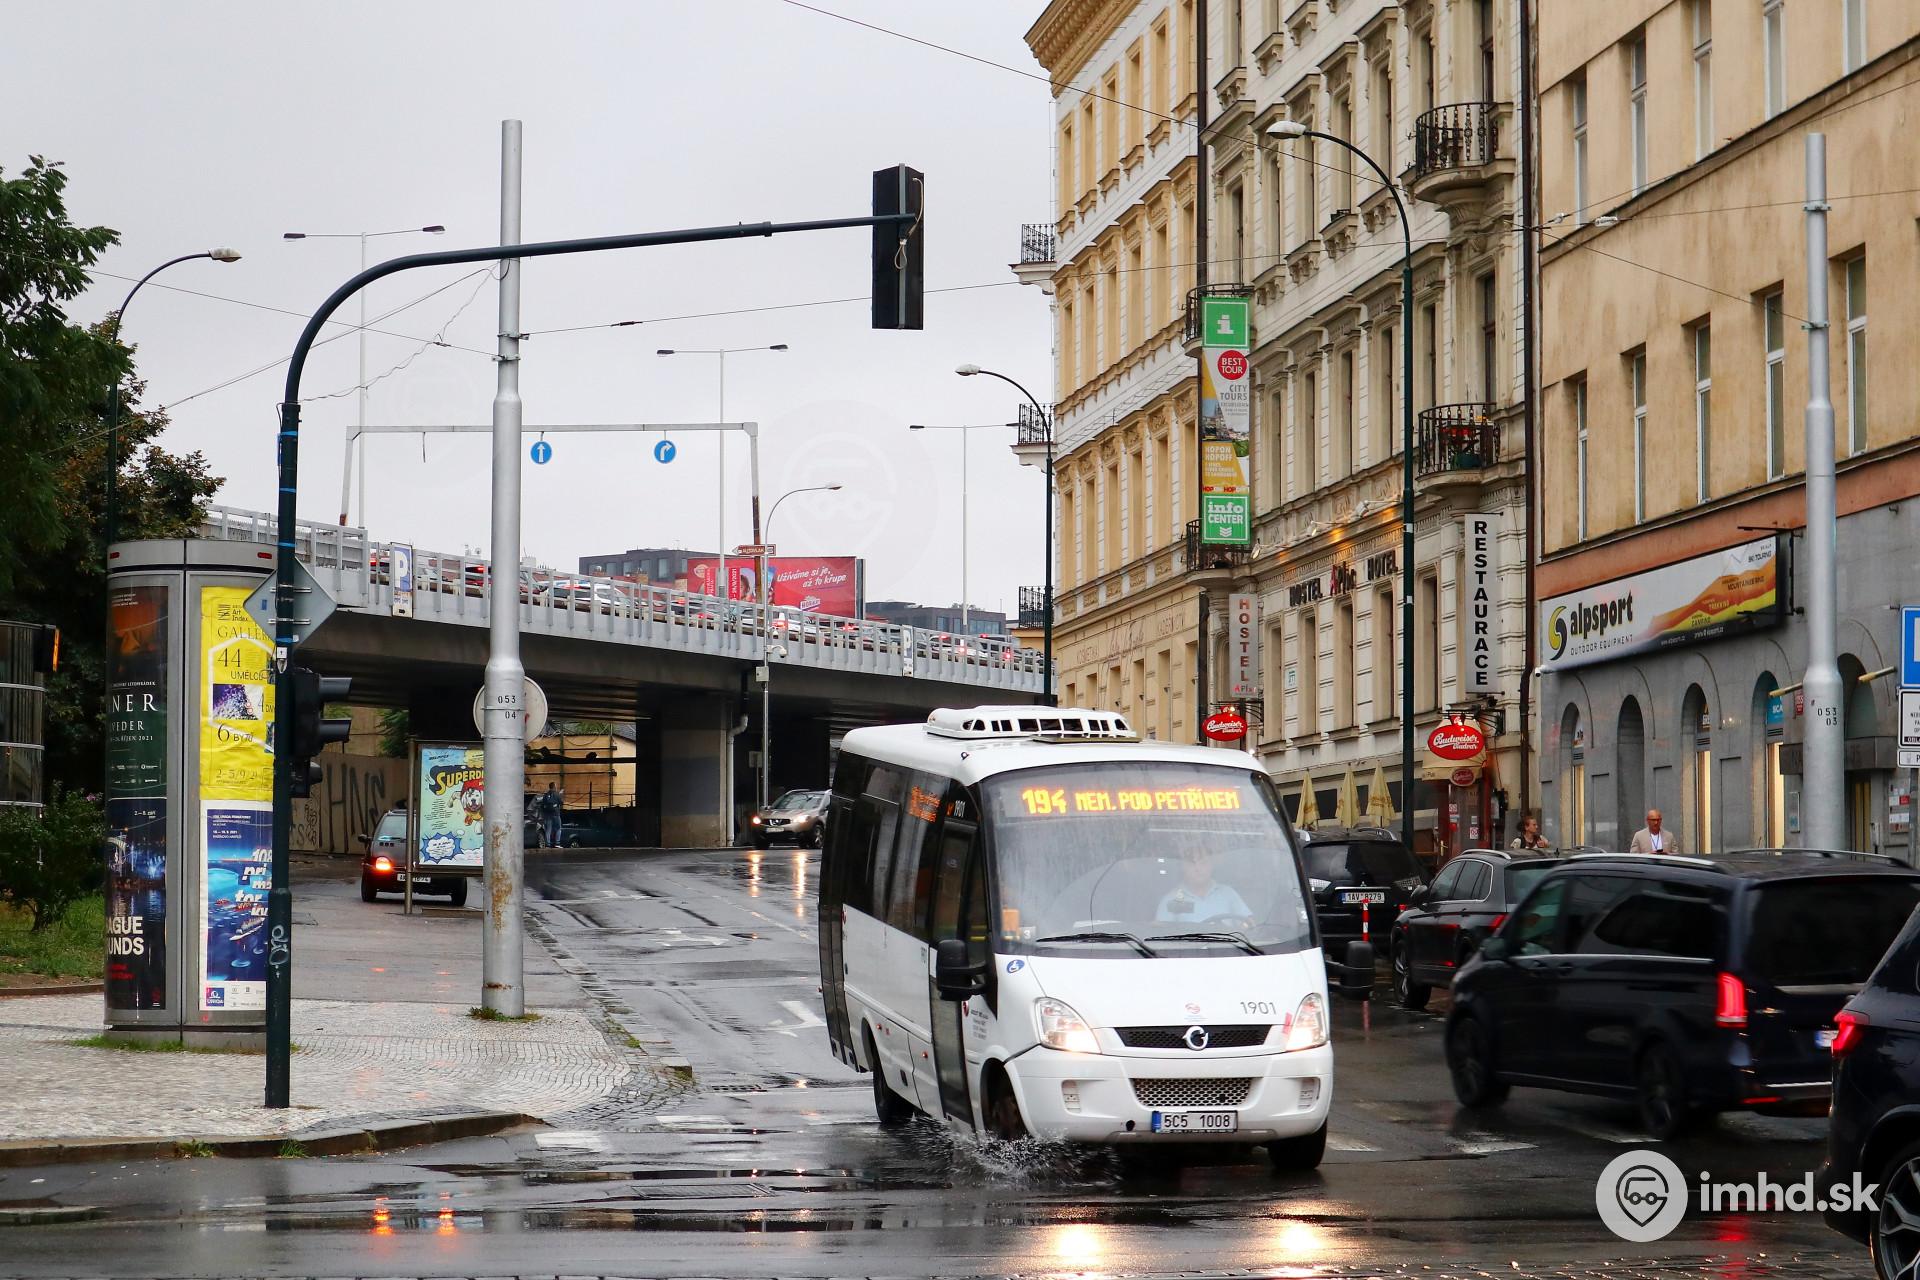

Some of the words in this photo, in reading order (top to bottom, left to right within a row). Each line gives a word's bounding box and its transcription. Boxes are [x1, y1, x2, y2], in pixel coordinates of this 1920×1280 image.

[1221, 357, 1243, 366] BEST
[1221, 366, 1243, 374] TOUR
[1229, 384, 1248, 393] CITY
[1220, 392, 1248, 401] TOURS
[1208, 501, 1244, 514] info
[1208, 514, 1244, 524] CENTER
[1367, 550, 1398, 581] HOTEL
[1474, 521, 1489, 686] RESTAURACE
[1570, 590, 1634, 639] alpsport
[1239, 599, 1250, 682] HOSTEL
[1570, 642, 1598, 656] OUTDOOR
[1599, 635, 1634, 650] EQUIPMENT
[217, 648, 241, 668] 44
[498, 695, 517, 704] 053
[505, 711, 517, 720] 04
[1826, 717, 1838, 726] 03
[217, 723, 230, 743] 6
[1433, 733, 1479, 748] Budweiser
[436, 769, 484, 796] SUPERD
[1022, 788, 1067, 816] 194
[1075, 791, 1117, 811] NEM.
[1119, 791, 1152, 810] POD
[1155, 787, 1241, 810] PETŘÍNEM
[242, 862, 268, 880] pri
[235, 889, 263, 903] tor
[1348, 893, 1360, 901] 1AV
[1365, 893, 1382, 901] 8279
[1240, 1001, 1277, 1016] 1901
[1164, 1114, 1188, 1128] 5C5
[1199, 1114, 1231, 1128] 1008
